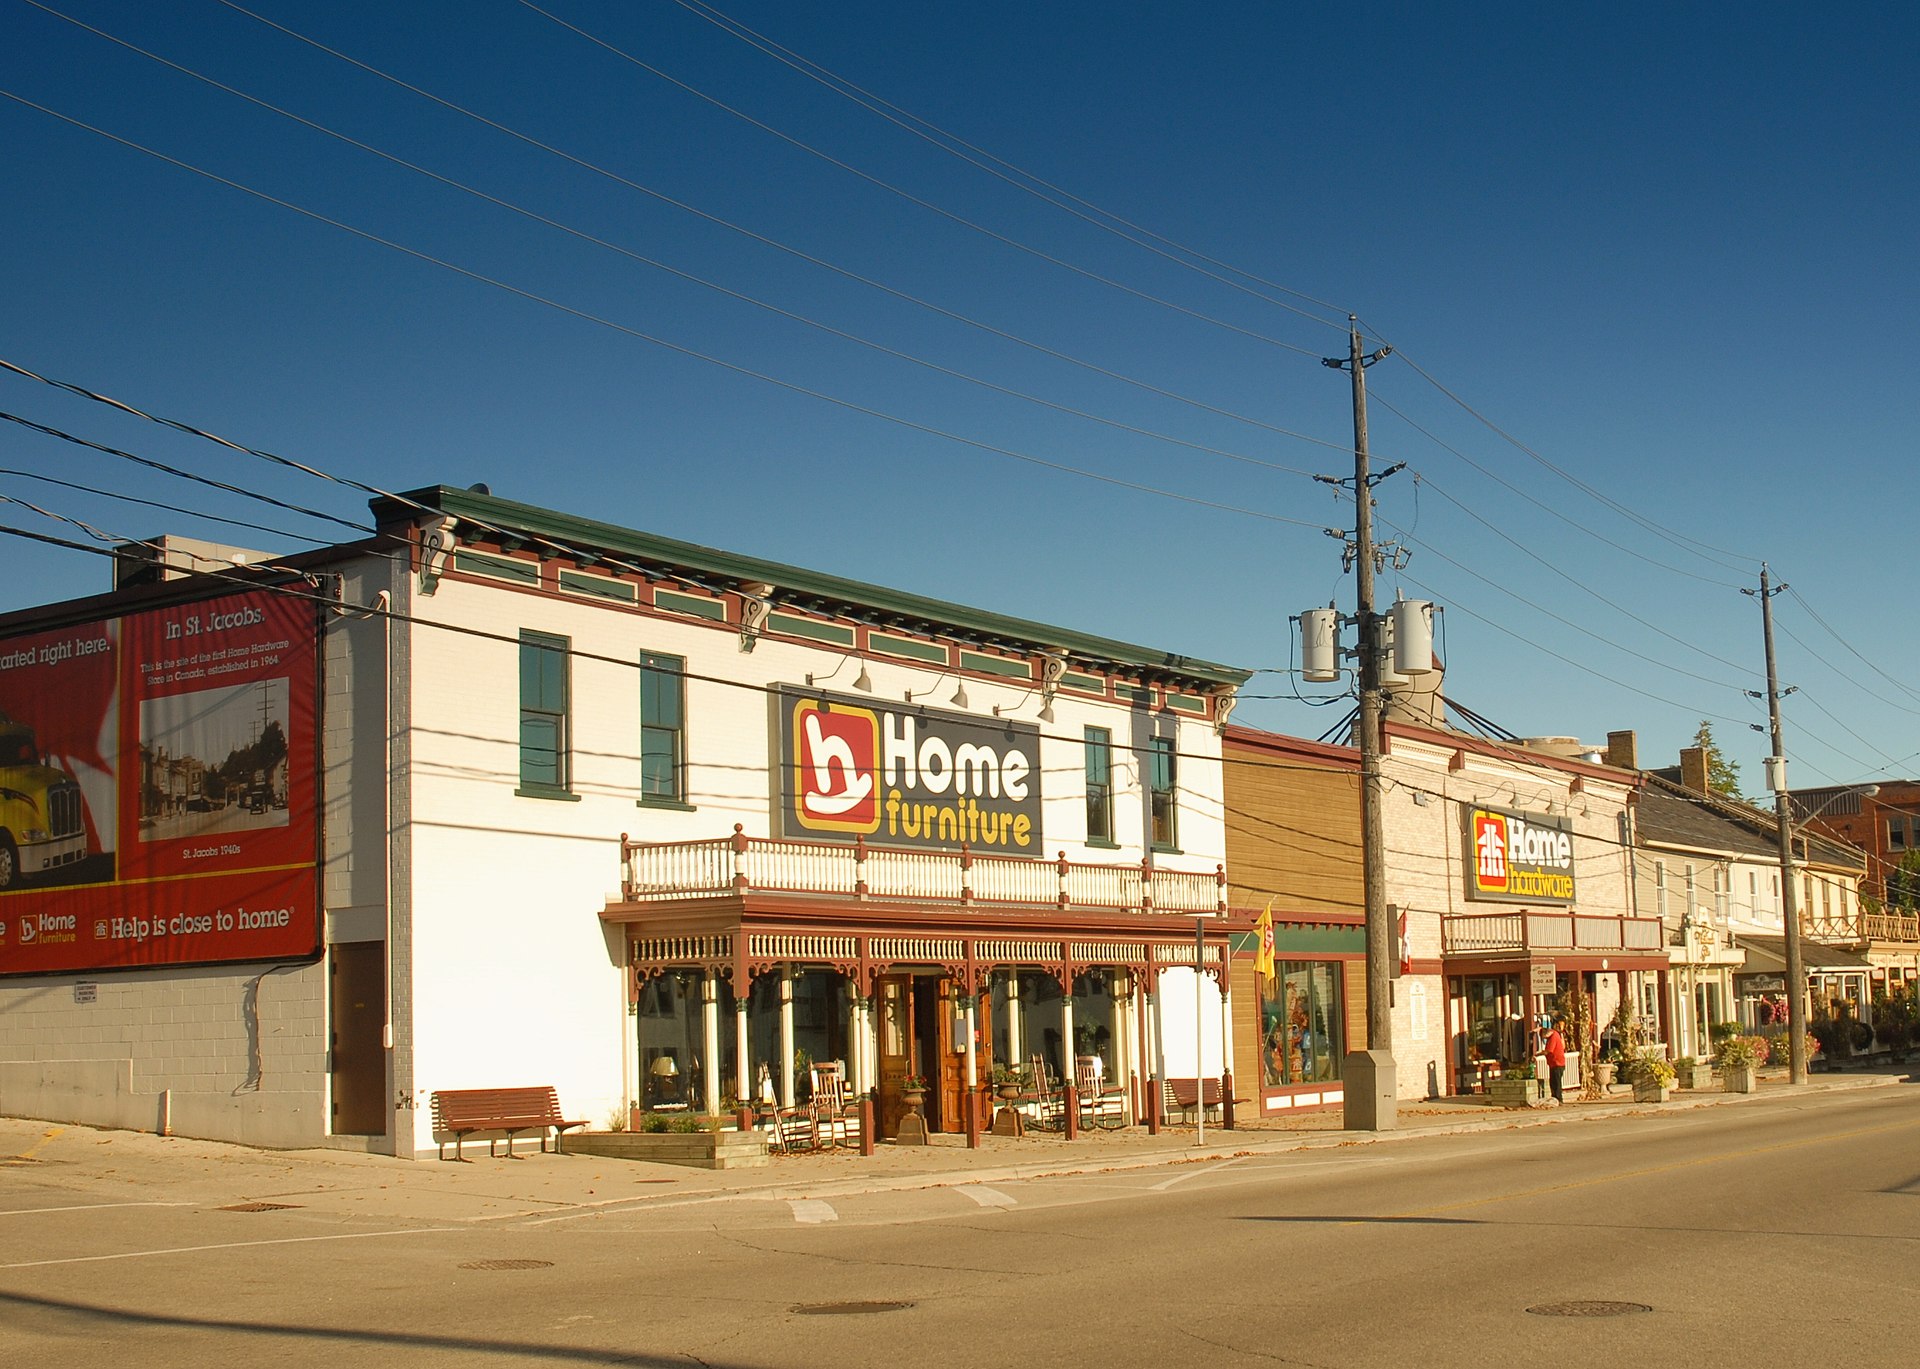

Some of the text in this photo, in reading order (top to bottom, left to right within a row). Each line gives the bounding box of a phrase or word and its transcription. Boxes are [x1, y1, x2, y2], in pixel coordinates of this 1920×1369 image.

[166, 606, 266, 640] In St. Jacobs.
[0, 638, 111, 670] arted right here.
[155, 661, 163, 671] is
[228, 647, 250, 658] Home
[251, 640, 289, 654] Hardware
[165, 674, 174, 683] in
[207, 660, 249, 675] established
[250, 659, 259, 668] in
[883, 712, 1030, 802] Home
[885, 789, 1032, 847] furniture
[192, 846, 219, 858] Jacobs
[220, 844, 241, 855] 1940s
[1506, 817, 1571, 869] Home
[1509, 863, 1573, 898] hardware
[39, 913, 76, 932] Home
[39, 931, 76, 944] furniture
[111, 916, 150, 942] Help
[152, 914, 167, 936] is
[169, 912, 213, 935] close
[216, 909, 234, 931] to
